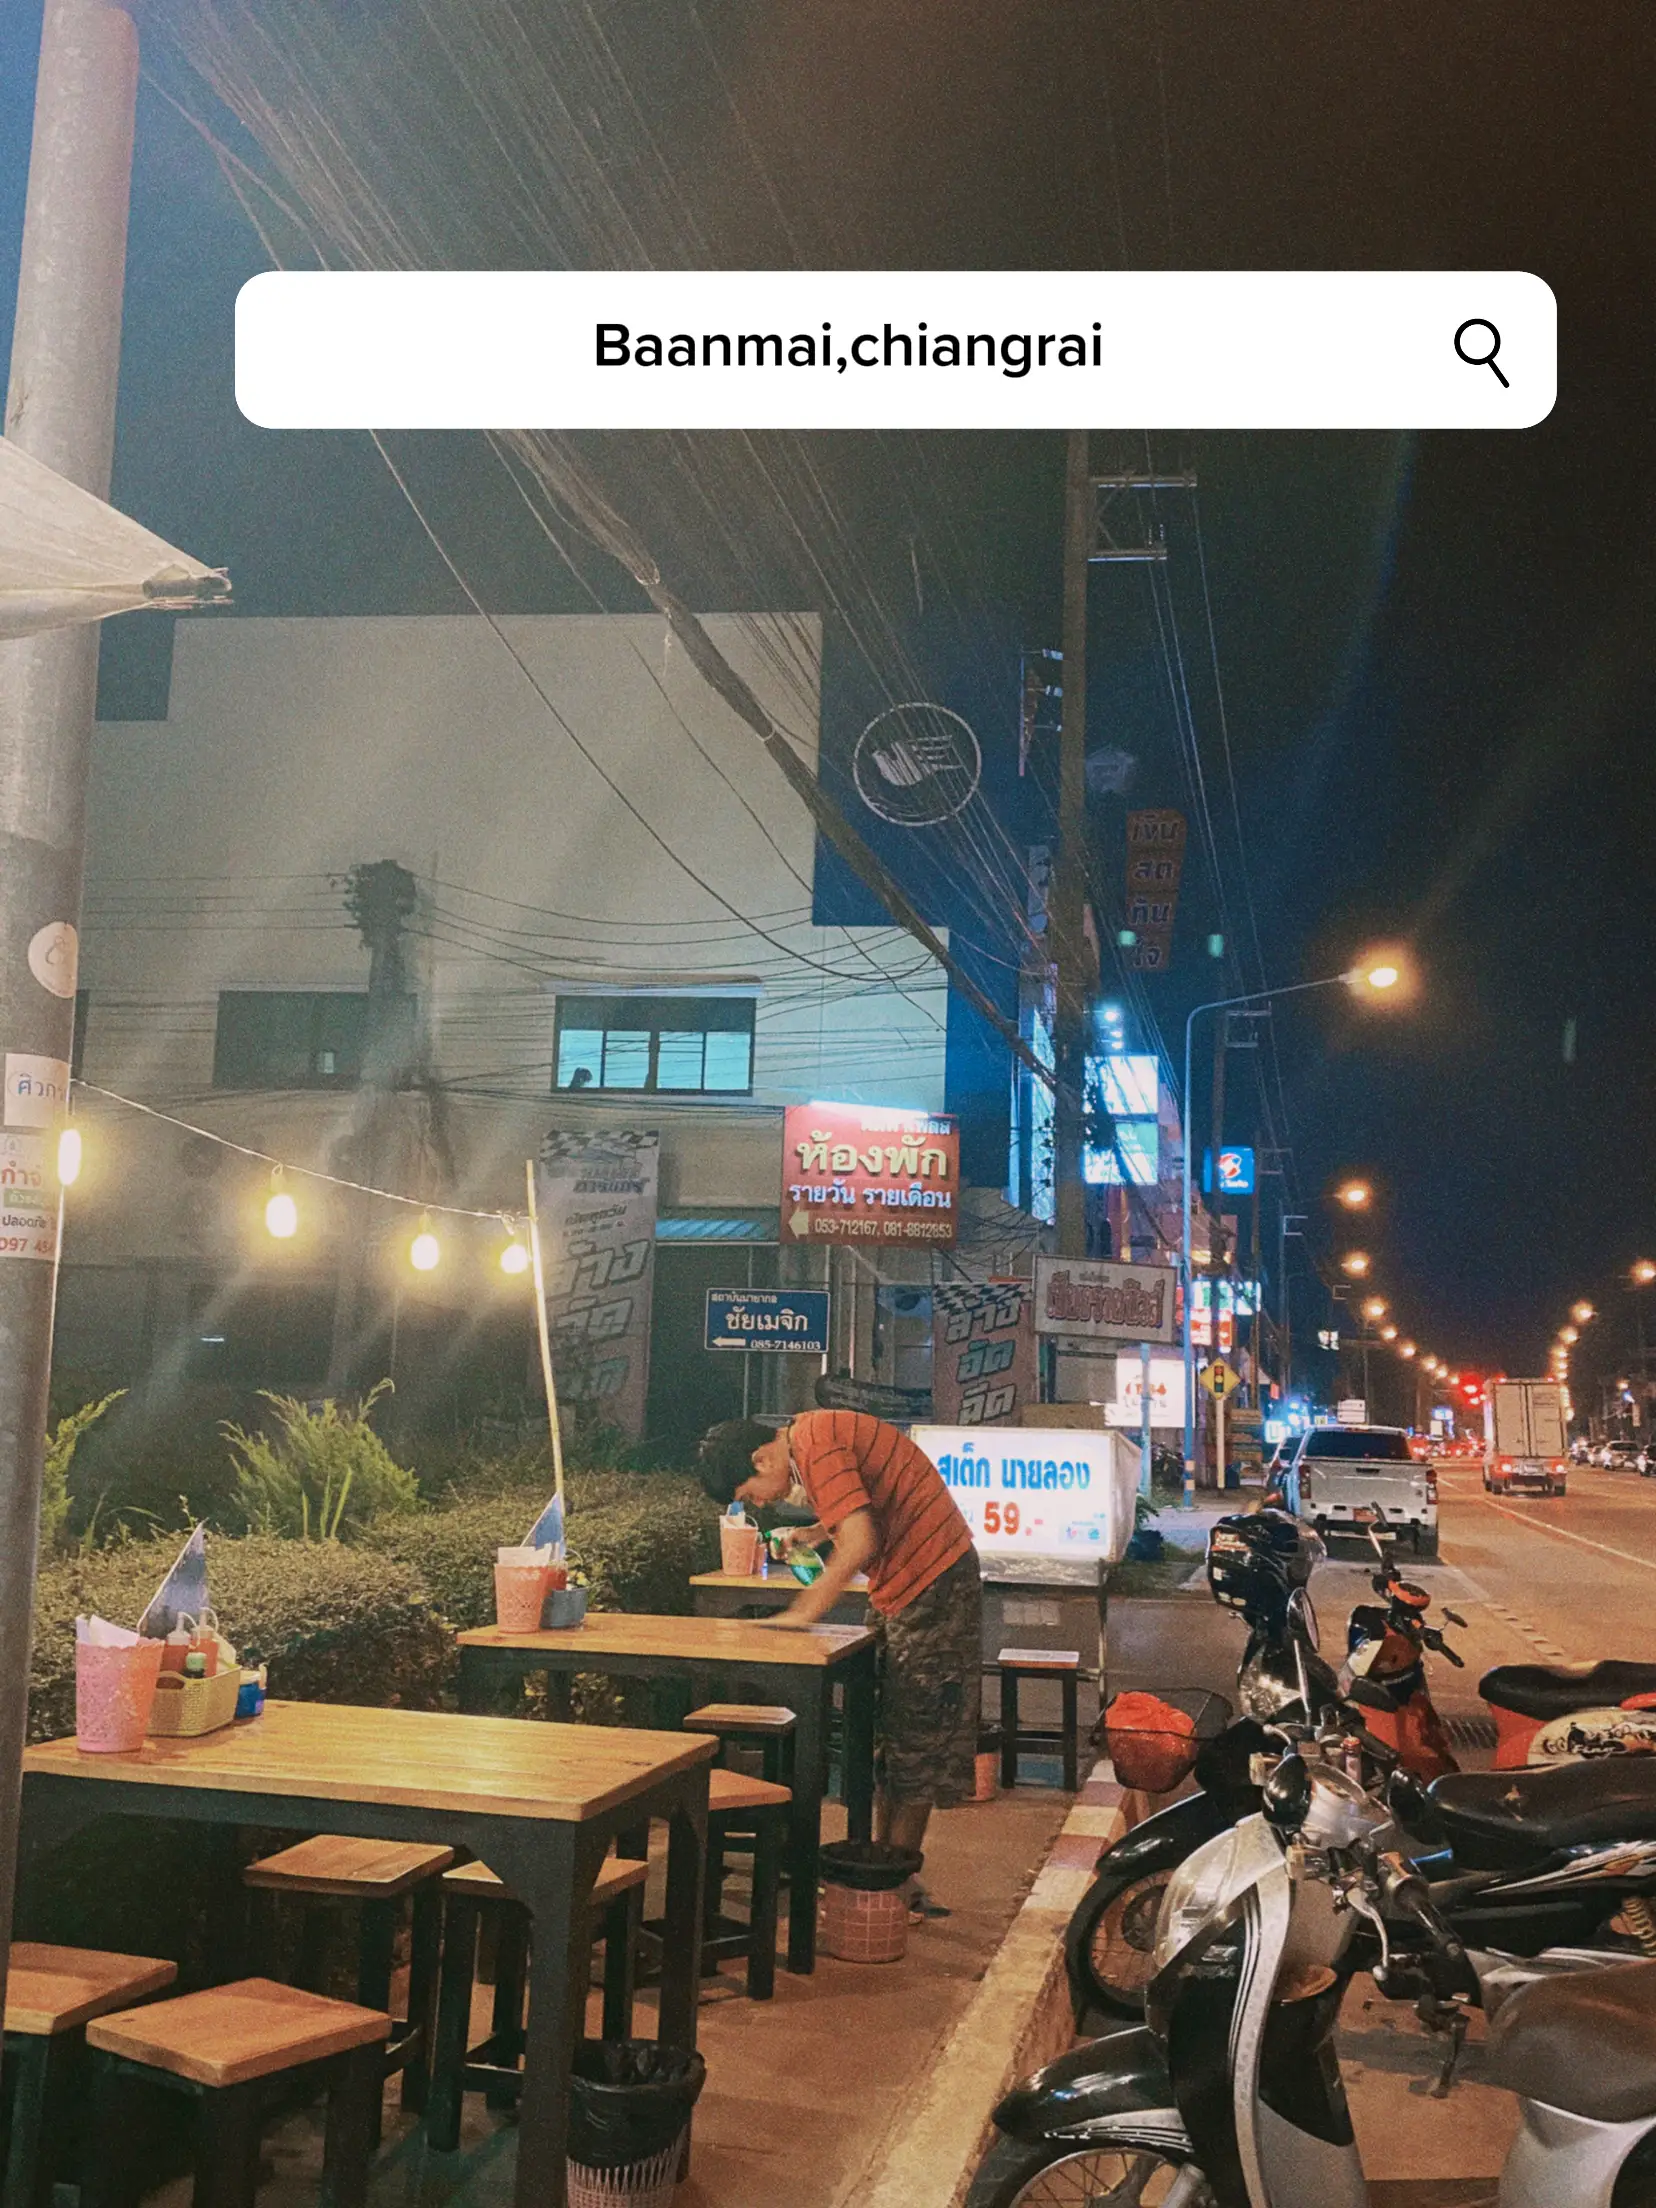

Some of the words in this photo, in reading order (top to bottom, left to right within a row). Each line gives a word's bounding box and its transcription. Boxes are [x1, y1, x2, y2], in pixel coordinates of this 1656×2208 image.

[796, 1129, 949, 1178] ห้องพัก
[789, 1177, 857, 1205] รายวัน
[862, 1181, 952, 1209] รายเดือน
[724, 1305, 809, 1332] ชัยเมจิก
[750, 1339, 821, 1351] 085-7146103
[937, 1441, 991, 1488] สเต็ก
[1000, 1457, 1091, 1490] นายลอง
